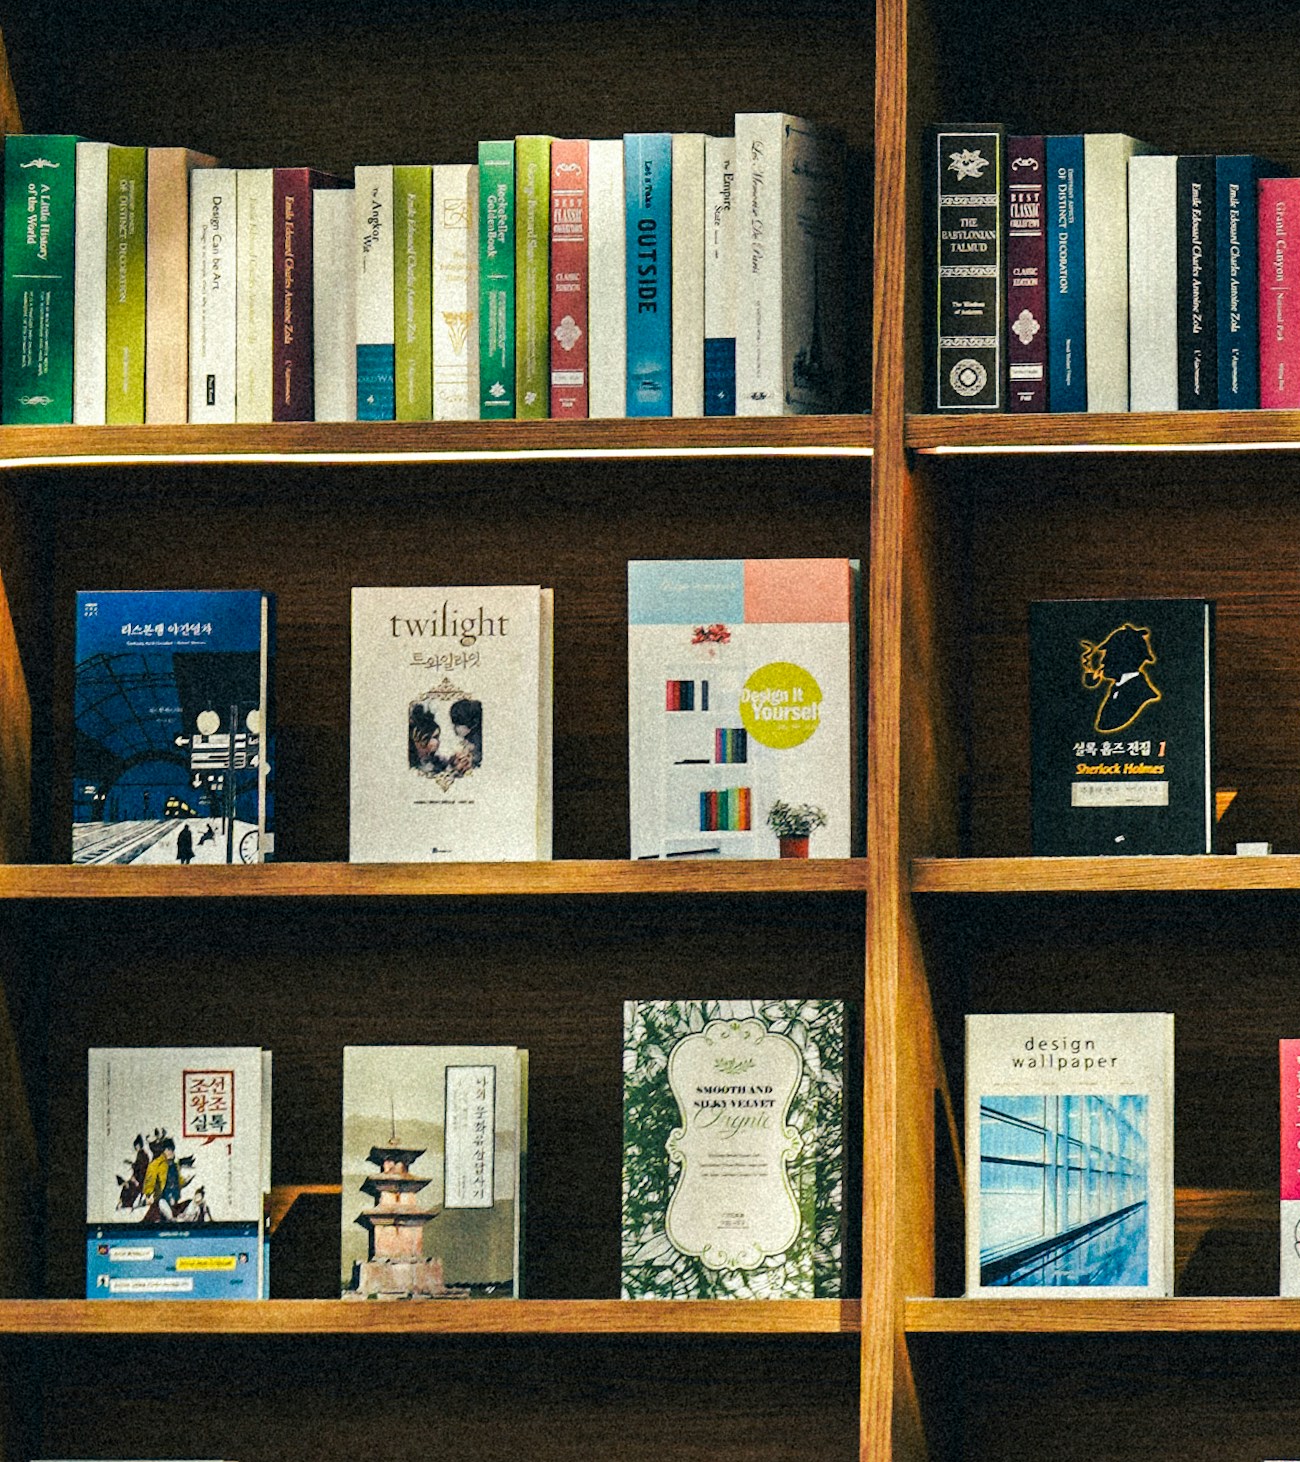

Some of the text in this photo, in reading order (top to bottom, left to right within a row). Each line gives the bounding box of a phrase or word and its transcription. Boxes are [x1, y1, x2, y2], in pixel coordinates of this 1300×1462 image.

[390, 600, 508, 647] twilight
[1024, 1036, 1095, 1054] design
[1012, 1054, 1117, 1071] wallpaper
